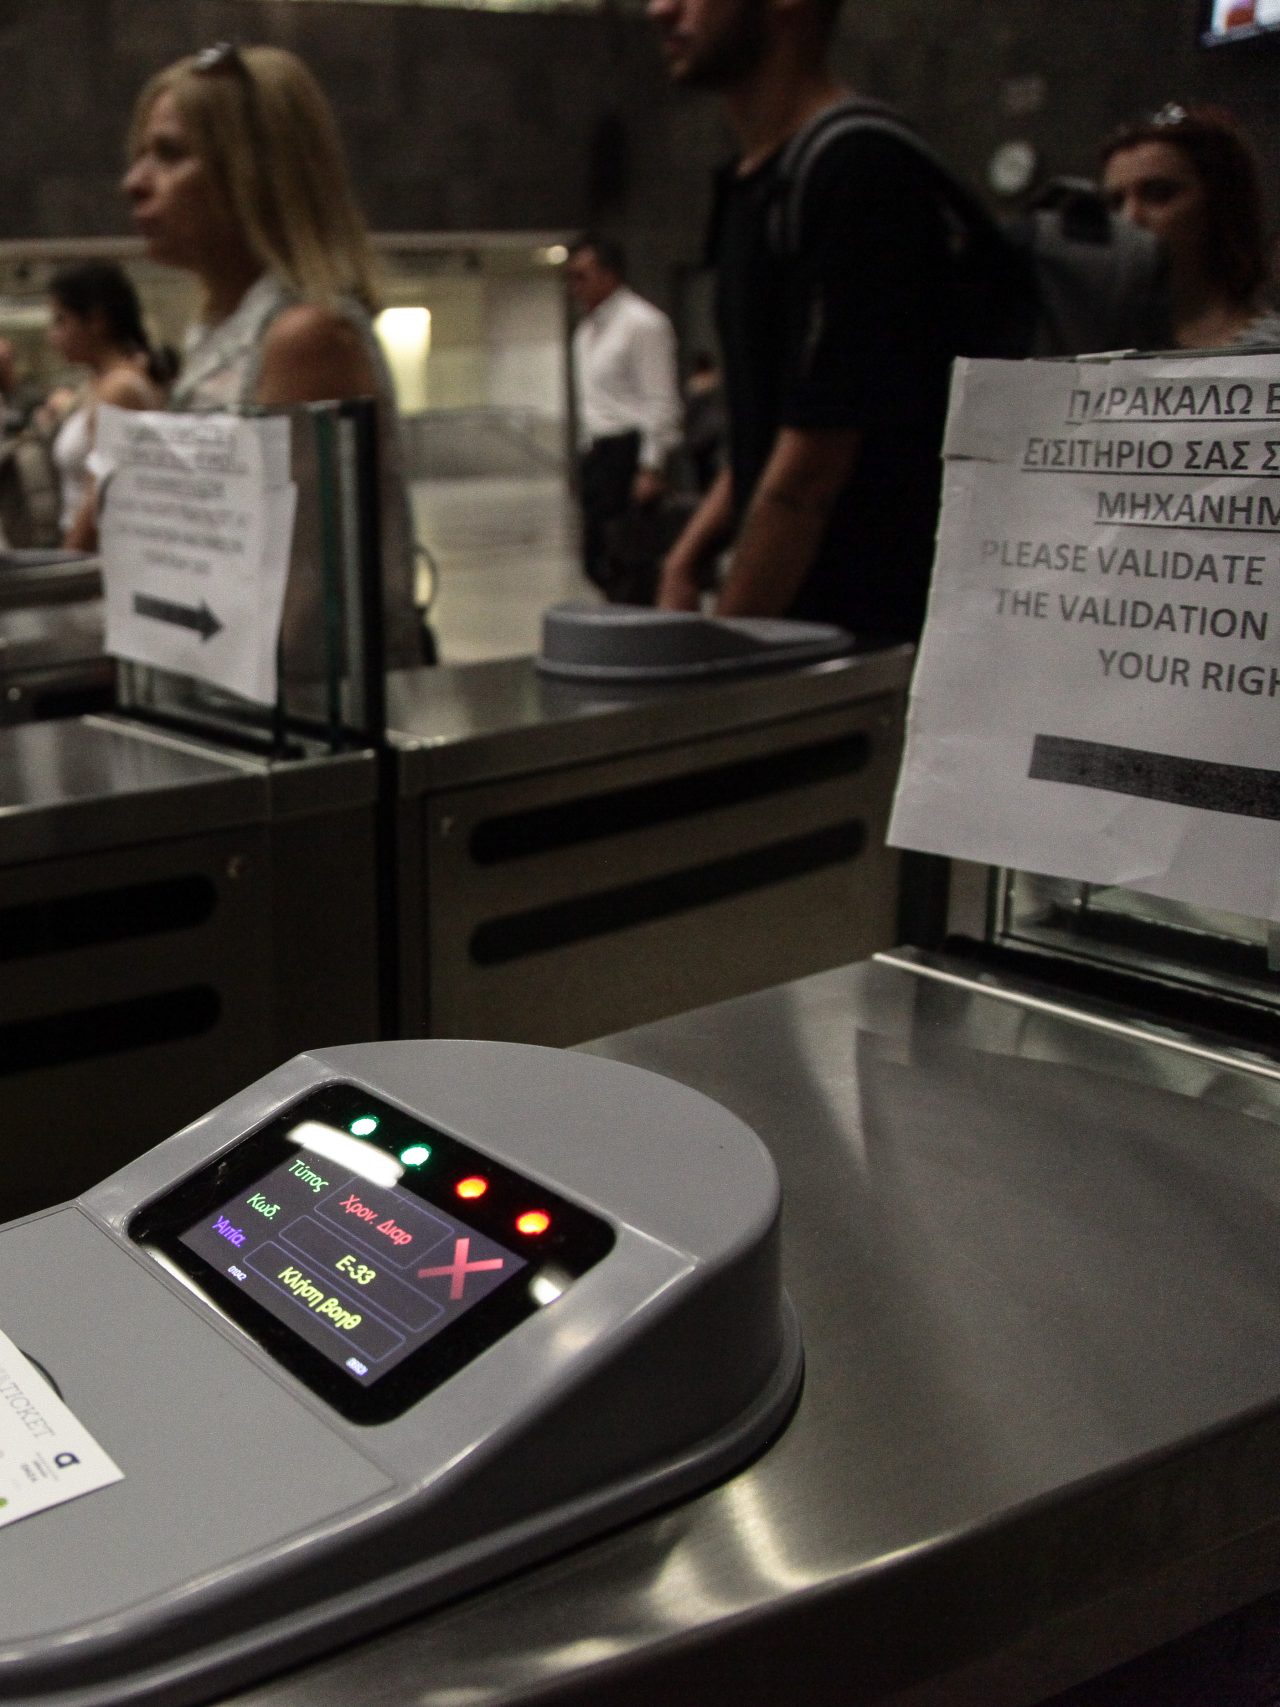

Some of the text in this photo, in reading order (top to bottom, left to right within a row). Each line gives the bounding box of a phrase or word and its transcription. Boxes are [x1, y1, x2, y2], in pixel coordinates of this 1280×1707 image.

[1023, 437, 1173, 469] ΕΙΣΙΤΗΡΙΟ
[1184, 440, 1251, 471] ΣΑΣ
[981, 538, 1267, 586] PLEASE VALIDATE
[994, 588, 1269, 641] THE VALIDATION
[1097, 648, 1191, 688] YOUR
[288, 1159, 329, 1193] Τύπος
[246, 1192, 281, 1220] Κωδ.
[376, 1219, 413, 1246] Διαρ
[277, 1266, 362, 1330] Κλήση βοηθ
